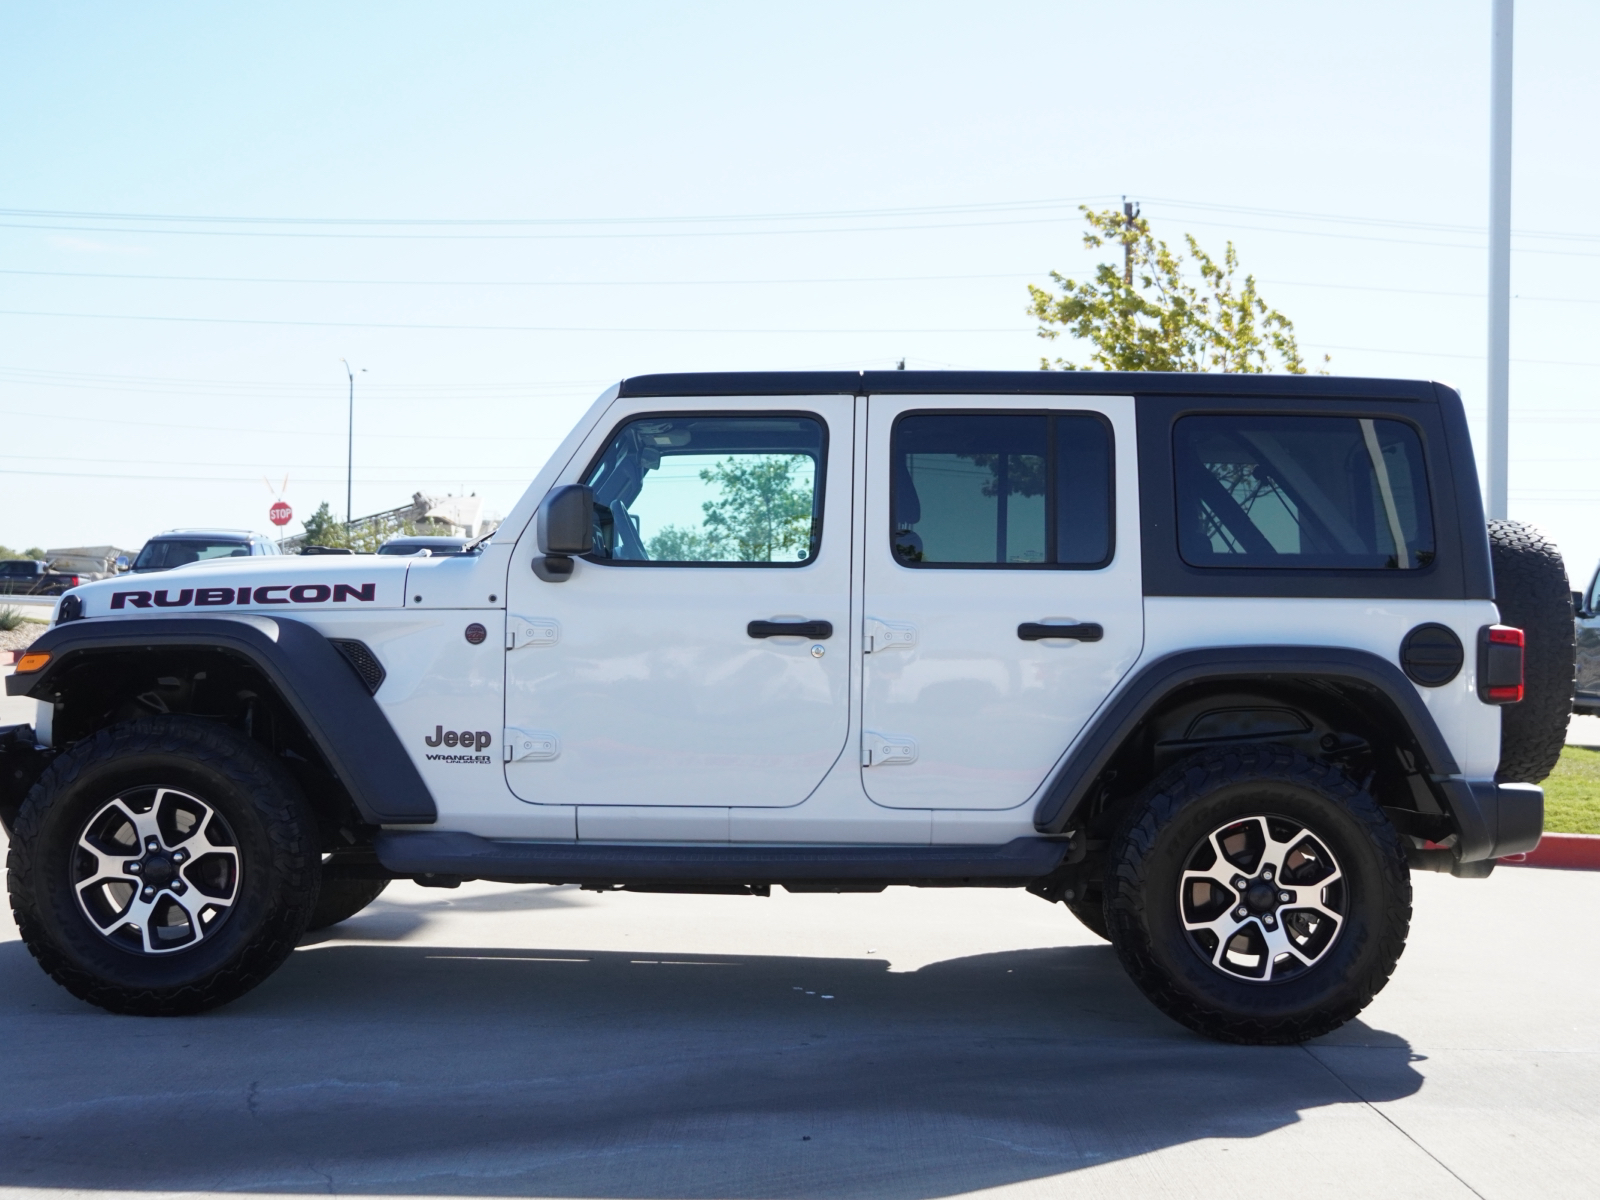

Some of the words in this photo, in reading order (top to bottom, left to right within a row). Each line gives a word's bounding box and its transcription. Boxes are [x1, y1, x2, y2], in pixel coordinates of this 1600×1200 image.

[270, 508, 292, 520] STOP
[110, 583, 376, 610] RUBICON
[425, 725, 491, 752] Jeep
[425, 753, 491, 762] WRANGLER
